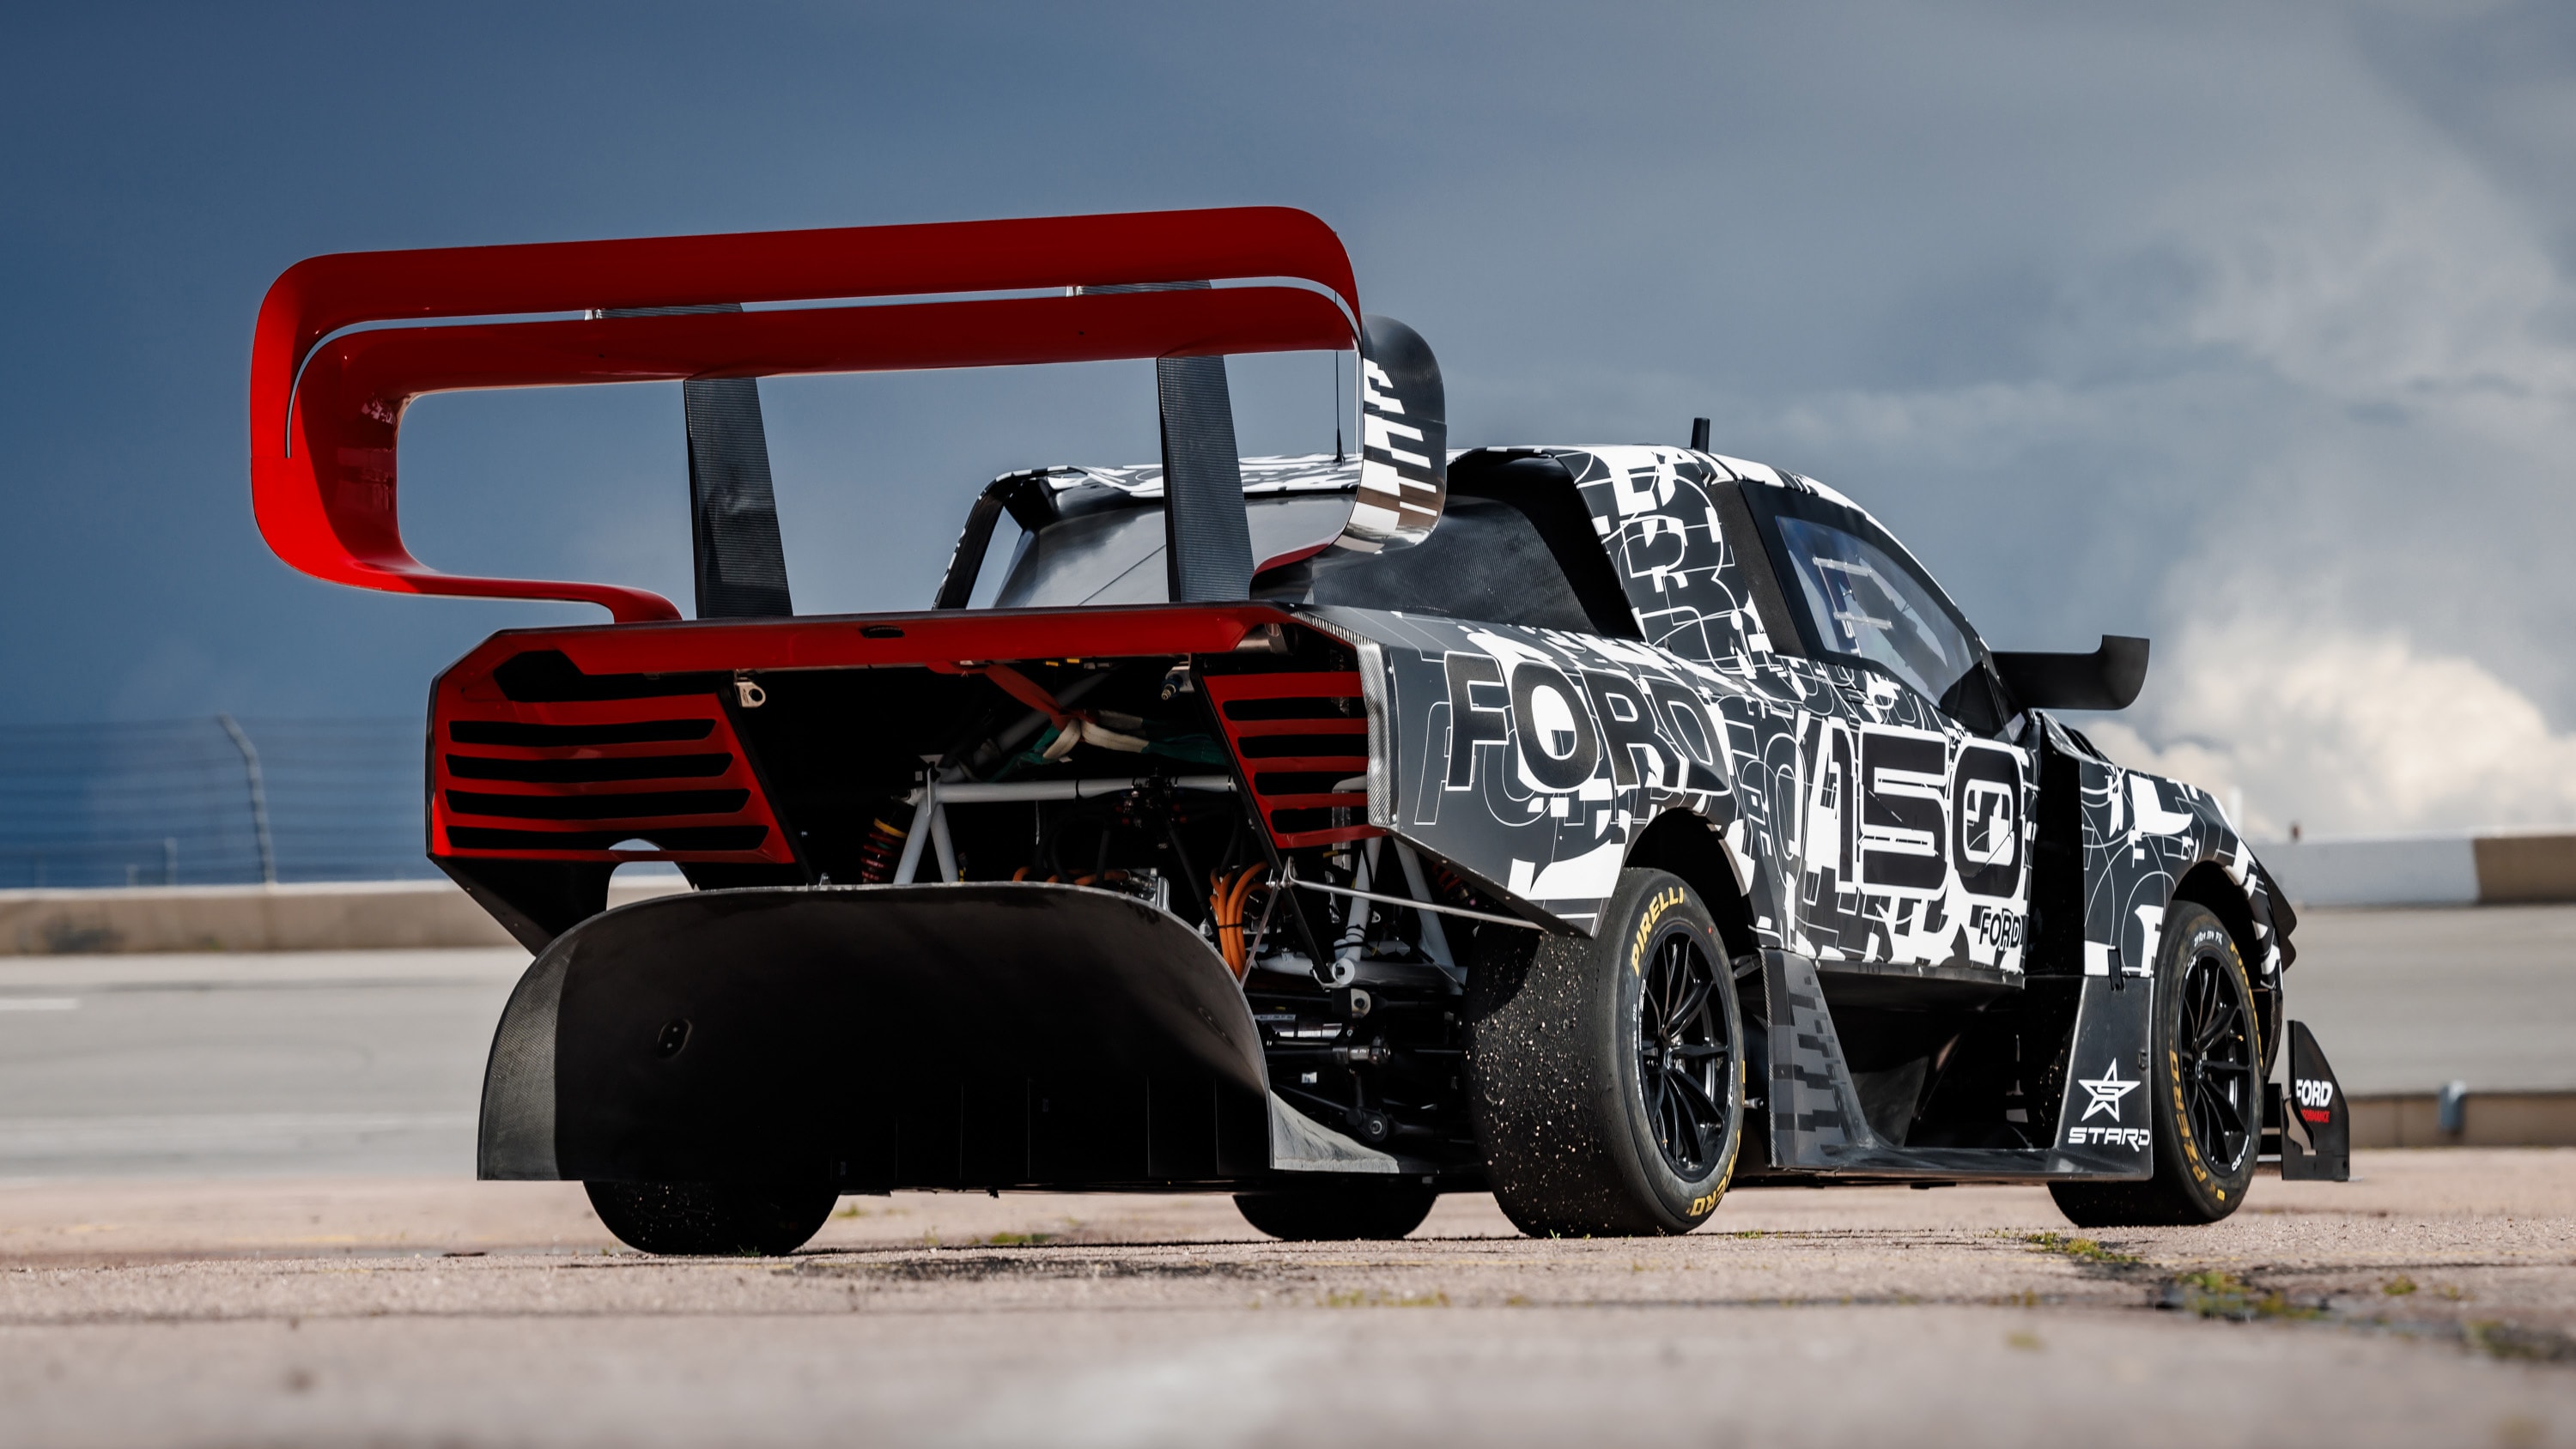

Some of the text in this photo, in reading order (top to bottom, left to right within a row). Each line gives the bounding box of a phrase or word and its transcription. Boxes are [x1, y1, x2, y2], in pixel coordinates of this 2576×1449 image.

[1444, 650, 1732, 795] FORD
[1826, 717, 2025, 900] 150
[1631, 886, 1685, 976] PIRELLI
[1978, 911, 2023, 949] FORD
[2295, 1079, 2333, 1107] FORD
[2068, 1126, 2151, 1152] STARD
